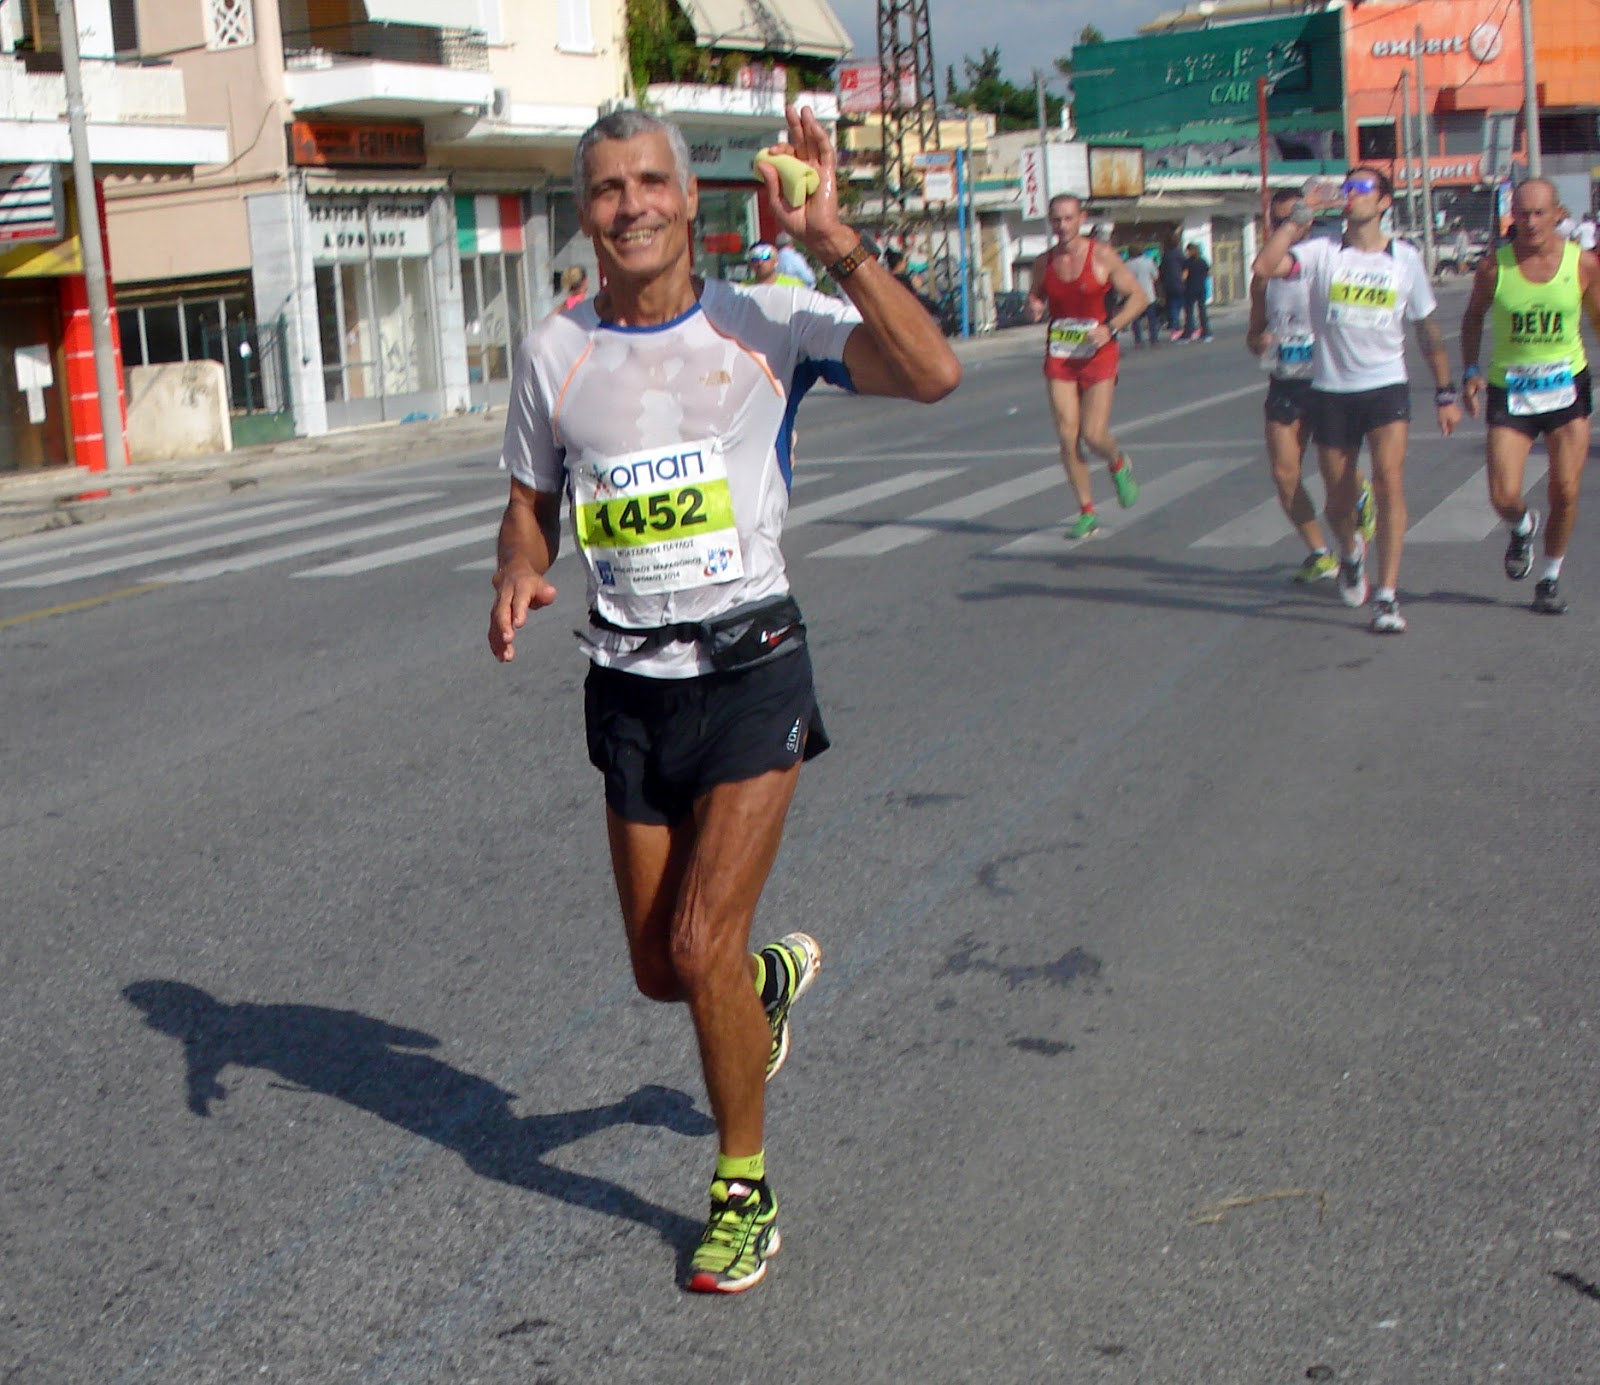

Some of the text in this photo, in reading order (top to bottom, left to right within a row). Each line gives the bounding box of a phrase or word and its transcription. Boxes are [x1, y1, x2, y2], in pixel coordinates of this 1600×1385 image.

[1372, 34, 1464, 60] expert
[1210, 81, 1251, 103] CAR
[1511, 311, 1563, 334] DEVA
[595, 488, 707, 538] 1452
